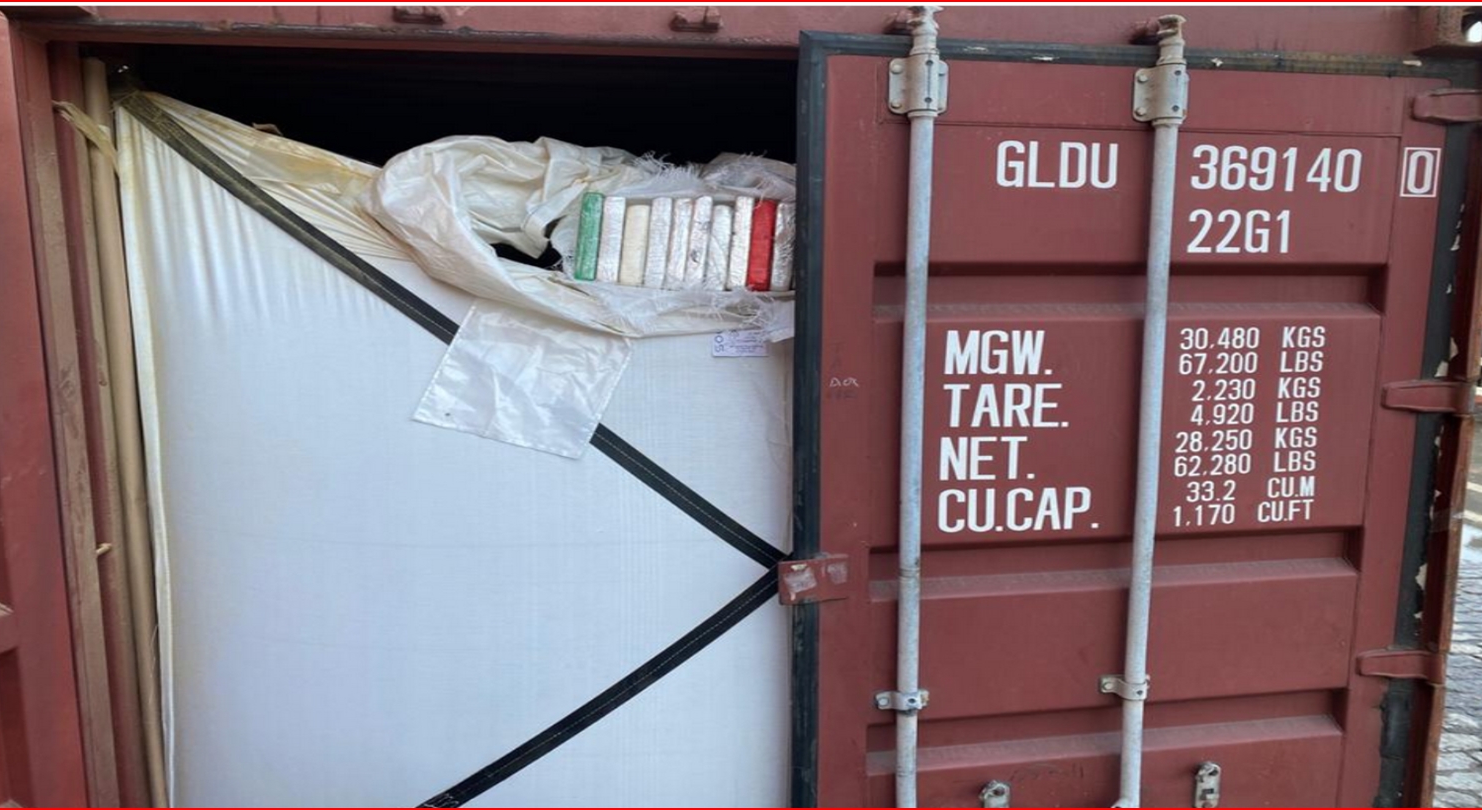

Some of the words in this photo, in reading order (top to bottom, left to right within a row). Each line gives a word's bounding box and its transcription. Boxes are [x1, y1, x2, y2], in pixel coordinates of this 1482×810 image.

[996, 140, 1118, 188] GLDU
[1190, 144, 1362, 192] 369140
[1406, 150, 1435, 194] 0
[1187, 209, 1290, 254] 22G1
[944, 330, 1052, 375] MGW.
[1180, 327, 1260, 350] 30,480
[1282, 326, 1326, 348] KGS
[1179, 352, 1258, 375] 67,200
[1280, 350, 1324, 373] LBS
[943, 383, 1069, 427] TARE.
[1191, 378, 1256, 401] 2,230
[1278, 376, 1321, 399] KGS
[1190, 403, 1254, 426] 4,920
[1276, 401, 1319, 423] LBS
[939, 436, 1035, 480] NET.
[1175, 429, 1252, 453] 28,250
[1275, 427, 1317, 449] KGS
[1174, 453, 1251, 477] 62,280
[1273, 450, 1316, 472] LBS
[938, 486, 1099, 533] CU.CAP.
[1186, 480, 1236, 502] 33.2
[1267, 476, 1315, 498] CU.M
[1173, 504, 1235, 527] 1,170
[1257, 499, 1314, 522] CU.FT
